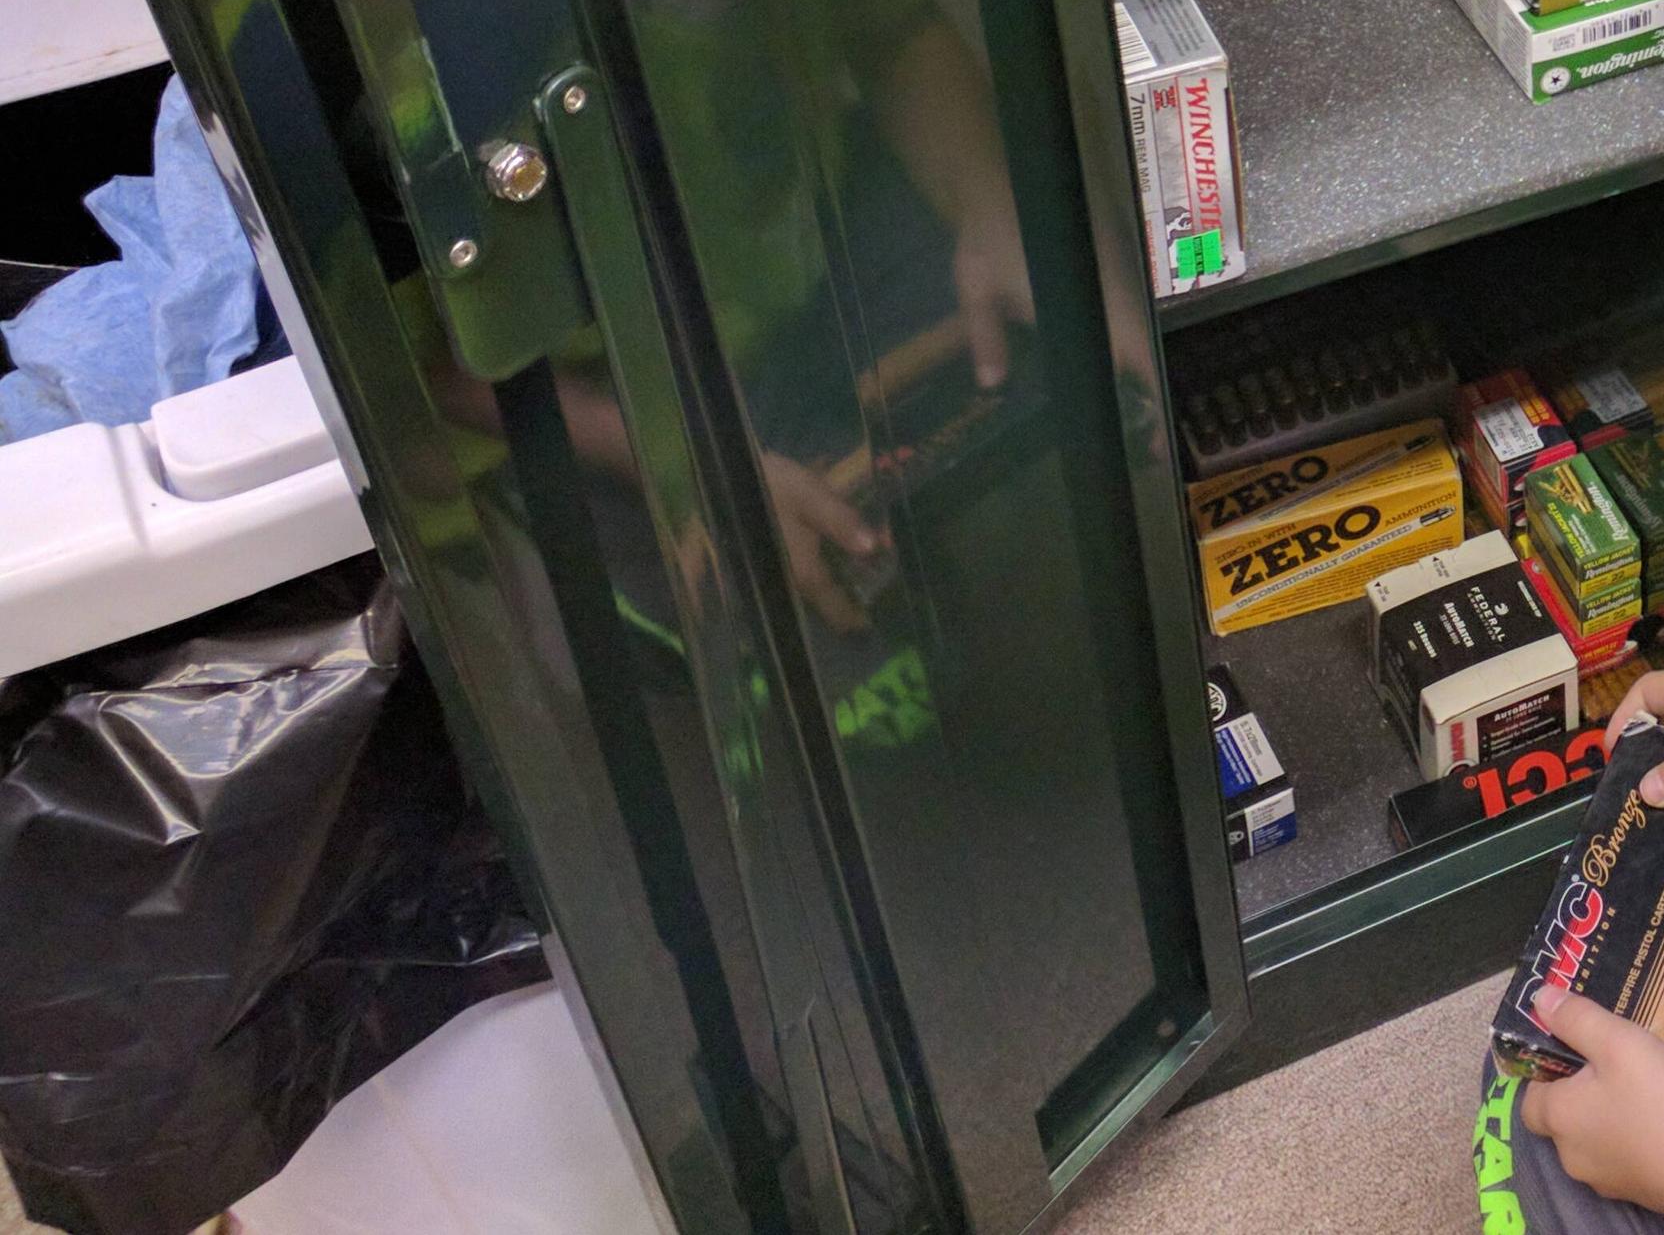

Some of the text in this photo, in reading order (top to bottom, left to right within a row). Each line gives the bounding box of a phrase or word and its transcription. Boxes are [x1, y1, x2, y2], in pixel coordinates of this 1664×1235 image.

[1130, 93, 1145, 135] 7mm
[1184, 78, 1223, 231] WINCHESTE
[1202, 456, 1329, 529] ZERO
[1384, 490, 1457, 527] AMMUNITION
[1219, 505, 1382, 597] ZERO
[1235, 559, 1340, 610] UNCONDITIONALLY
[1341, 523, 1413, 562] GUARANTEED
[1470, 586, 1506, 643] FEDERAL
[1582, 788, 1647, 888] Bronze
[1575, 906, 1616, 993] UNITION
[1613, 967, 1641, 1014] TERFIRE
[1632, 929, 1657, 968] PISTOL
